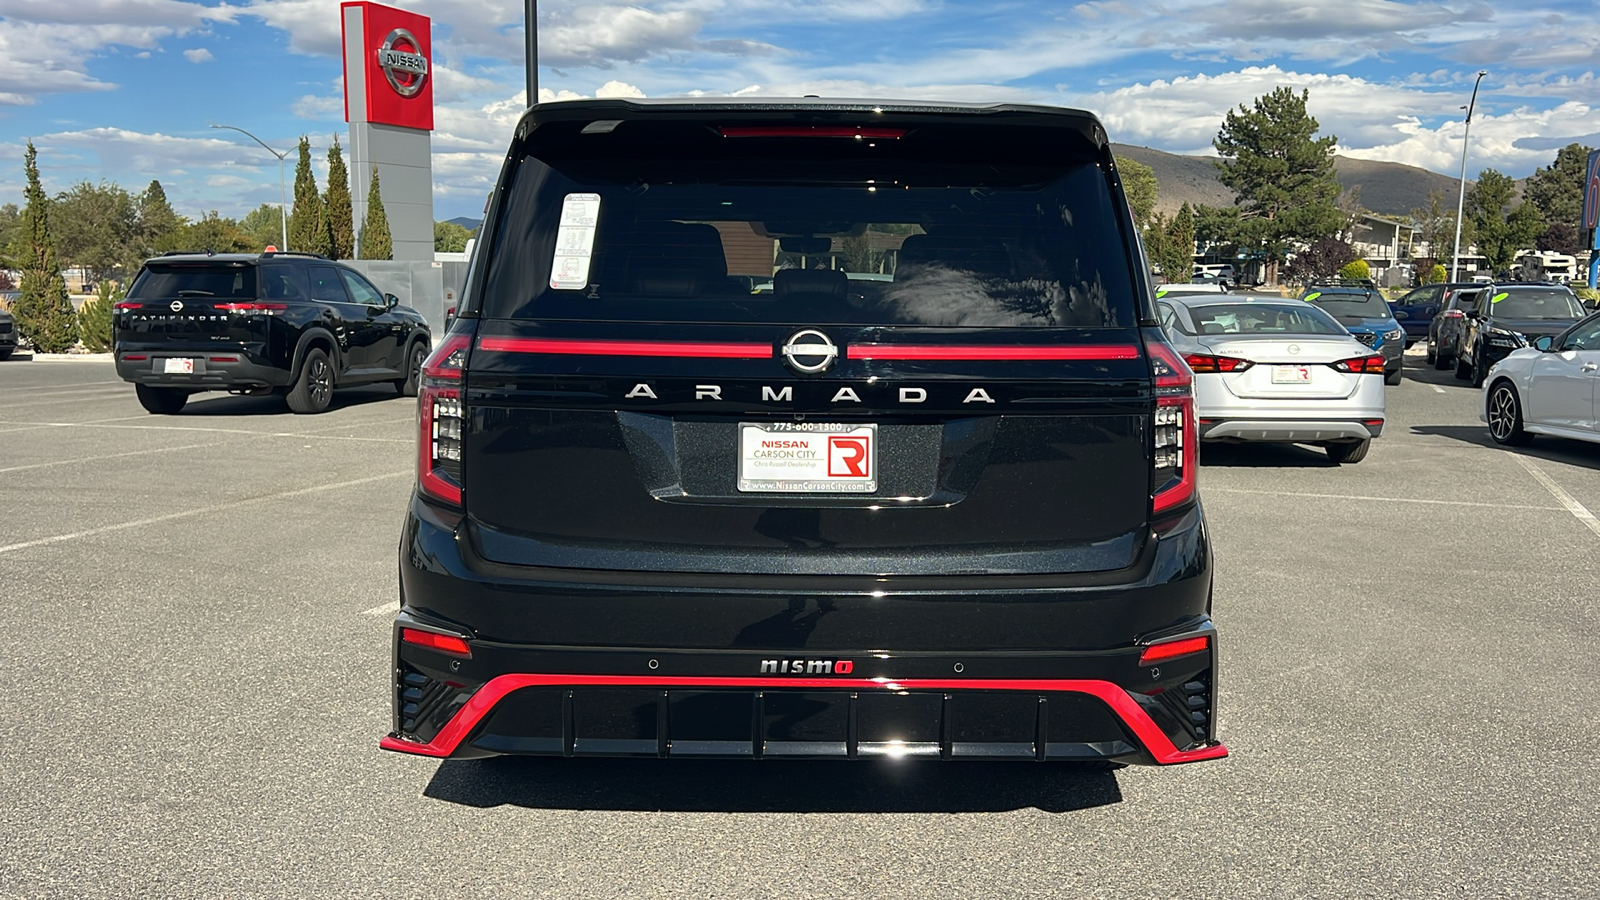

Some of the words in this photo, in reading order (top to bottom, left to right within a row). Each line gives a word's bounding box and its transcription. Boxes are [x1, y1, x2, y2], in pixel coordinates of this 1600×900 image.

[387, 53, 426, 71] NISSAN
[625, 383, 995, 403] ARMADA
[773, 422, 842, 431] 775-600-1500
[761, 440, 809, 448] NISSAN
[753, 450, 794, 459] CARSON
[796, 450, 817, 459] CITY
[788, 461, 816, 469] Dealership
[752, 481, 864, 491] www.NissanCarsonCity.com
[760, 660, 853, 674] nismo
